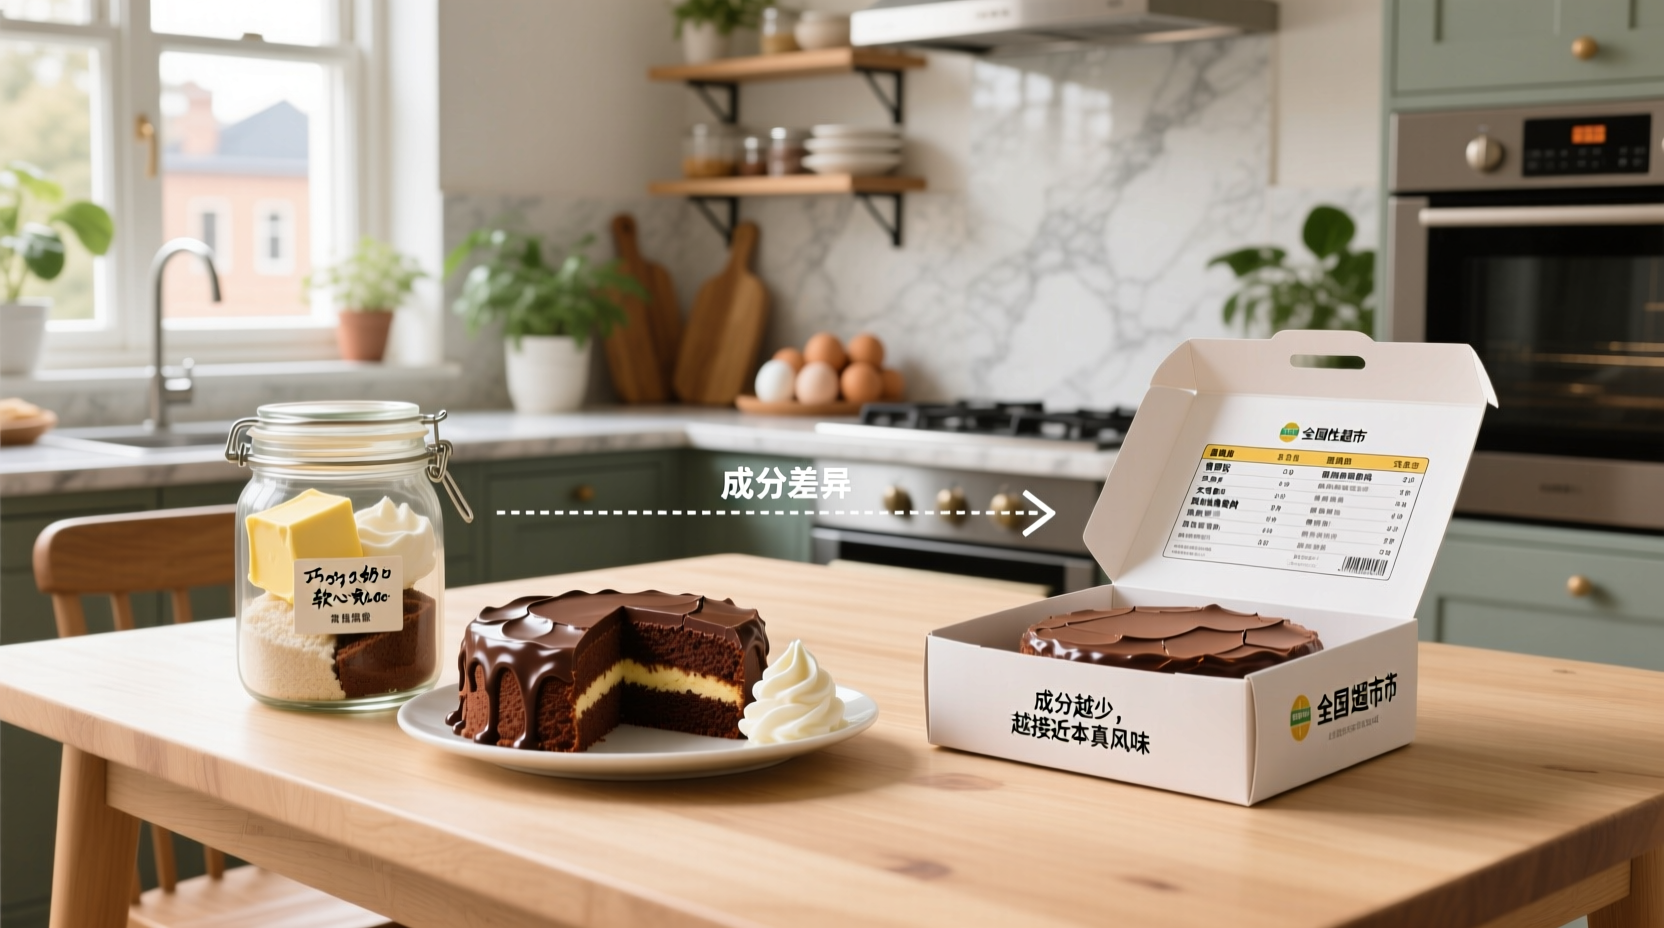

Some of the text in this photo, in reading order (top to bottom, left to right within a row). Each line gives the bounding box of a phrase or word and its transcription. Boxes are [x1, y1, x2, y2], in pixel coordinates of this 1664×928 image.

[1011, 711, 1151, 755] 越接近本真风味
